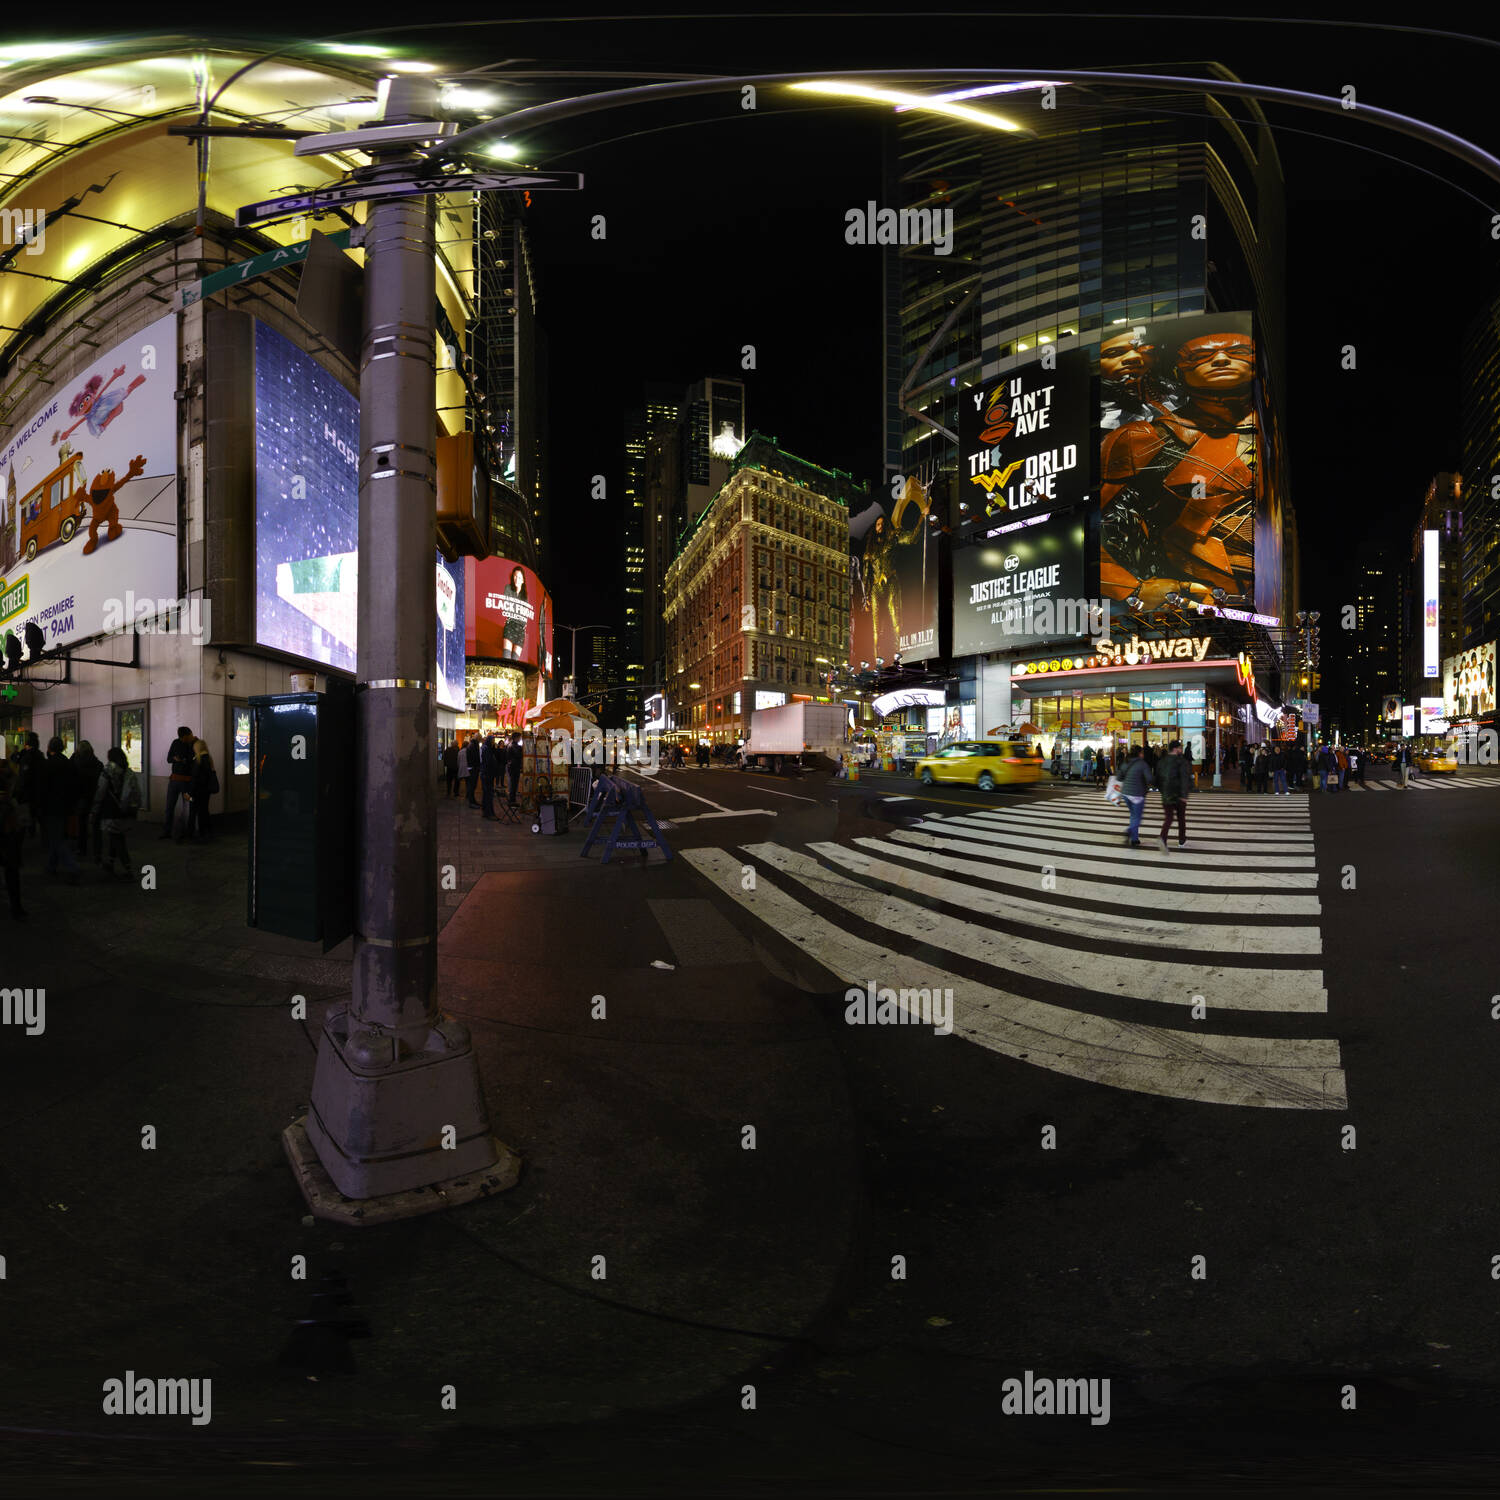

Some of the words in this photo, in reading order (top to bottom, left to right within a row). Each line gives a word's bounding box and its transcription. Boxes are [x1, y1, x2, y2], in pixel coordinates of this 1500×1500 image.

[277, 188, 365, 211] ONE
[412, 176, 522, 190] WAY
[237, 260, 255, 278] 7
[8, 446, 16, 462] IS
[16, 402, 58, 449] WELCOME
[1004, 554, 1020, 572] DC
[969, 576, 1011, 605] JUSTICE
[1014, 564, 1060, 595] LEAGUE
[1, 582, 26, 617] STREET
[40, 595, 75, 622] PREMIERE
[485, 597, 515, 612] BLACK
[51, 614, 74, 639] 9AM
[991, 611, 1003, 625] ALL
[1014, 604, 1034, 619] 11.17
[900, 636, 910, 648] ALL
[918, 628, 934, 643] 11.17
[1096, 633, 1211, 662] Subway
[894, 692, 931, 707] LOFT
[496, 698, 531, 729] H&M
